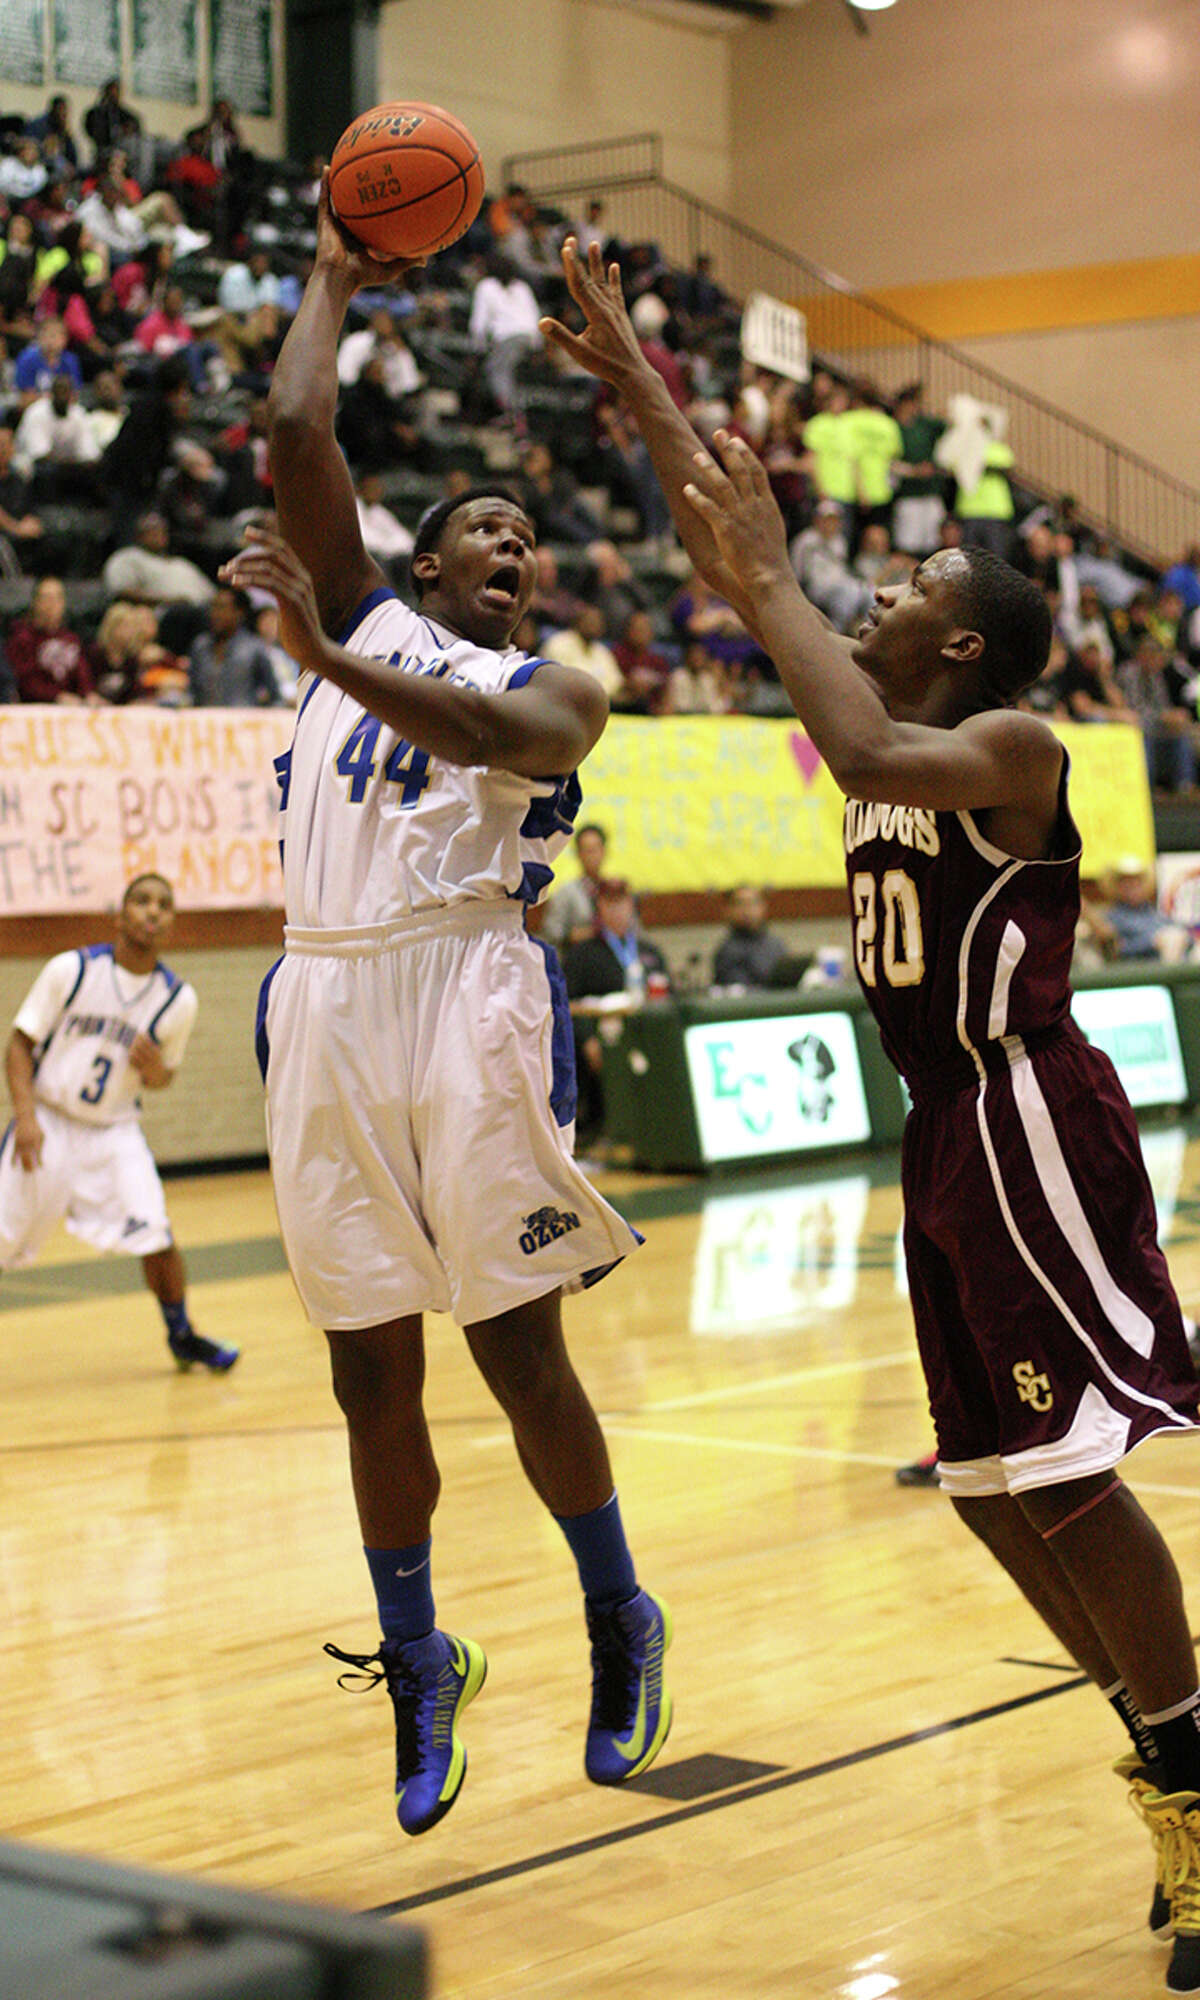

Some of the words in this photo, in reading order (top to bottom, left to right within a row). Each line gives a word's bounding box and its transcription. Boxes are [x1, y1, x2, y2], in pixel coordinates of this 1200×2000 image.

[333, 709, 433, 810] 44
[46, 780, 98, 837] SC
[0, 840, 92, 901] THE
[852, 868, 925, 988] 20
[79, 1054, 112, 1105] 3
[518, 1210, 582, 1255] OZEN
[1011, 1360, 1053, 1412] SC
